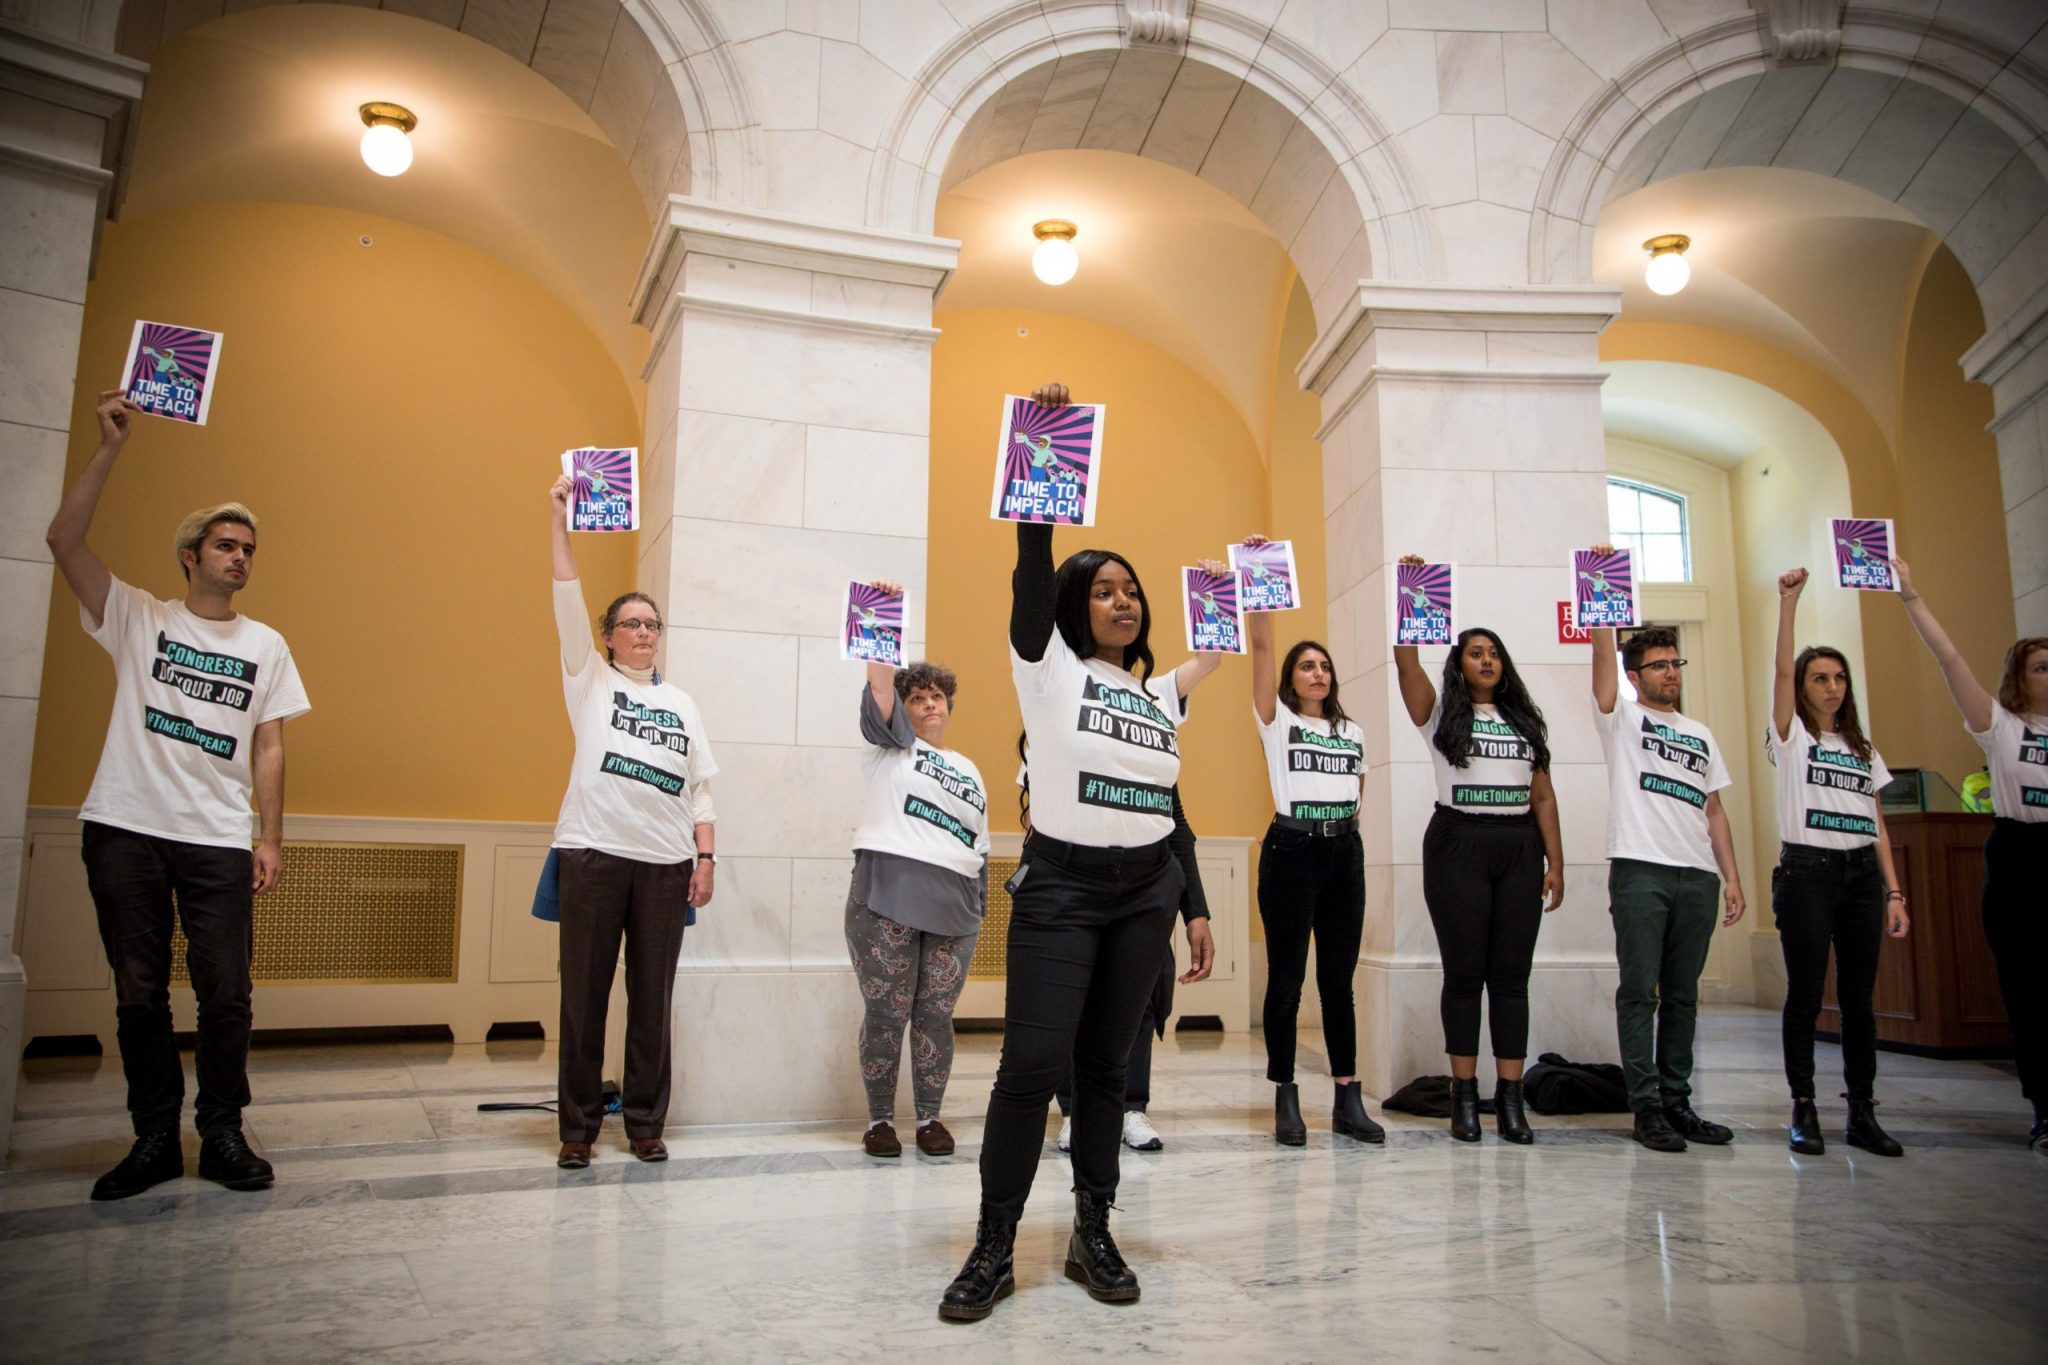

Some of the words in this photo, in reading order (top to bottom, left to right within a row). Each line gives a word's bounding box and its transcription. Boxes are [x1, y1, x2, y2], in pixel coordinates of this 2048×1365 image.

[137, 379, 172, 397] TIME
[175, 386, 195, 402] TO
[130, 391, 195, 416] IMPEACH
[1012, 479, 1050, 498] TIME
[1056, 483, 1078, 499] TO
[578, 501, 607, 514] TIME
[610, 501, 626, 514] TO
[1005, 495, 1080, 517] IMPEACH
[576, 514, 629, 526] IMPEACH
[1842, 564, 1869, 575] TIME
[1870, 566, 1887, 577] TO
[1842, 574, 1891, 586] IMPEACH
[1244, 586, 1270, 598] TIME
[1271, 584, 1286, 595] TO
[1243, 594, 1290, 608] IMPEACH
[1582, 601, 1609, 612] TIME
[1612, 600, 1628, 611] TO
[1403, 617, 1428, 629] TIME
[1431, 617, 1446, 629] TO
[1581, 611, 1631, 623] IMPEACH
[1195, 623, 1220, 635] TIME
[1221, 624, 1234, 636] TO
[1400, 629, 1448, 640] IMPEACH
[851, 636, 878, 650] TIME
[880, 640, 896, 652] TO
[1194, 634, 1237, 648] IMPEACH
[166, 643, 244, 677] CONGRESS
[848, 646, 899, 662] IMPEACH
[158, 661, 175, 683] DO
[174, 675, 214, 700] YOUR
[216, 686, 246, 707] JOB
[1088, 709, 1113, 735] DO
[1118, 719, 1164, 750] YOUR
[1472, 720, 1516, 735] ONGRE
[664, 735, 685, 752] JOB
[1478, 740, 1519, 757] YOUR
[1294, 751, 1312, 770] DO
[1315, 754, 1349, 773] YOUR
[2026, 748, 2046, 764] DO
[1829, 771, 1859, 791] YOUR
[966, 790, 985, 811] JOB
